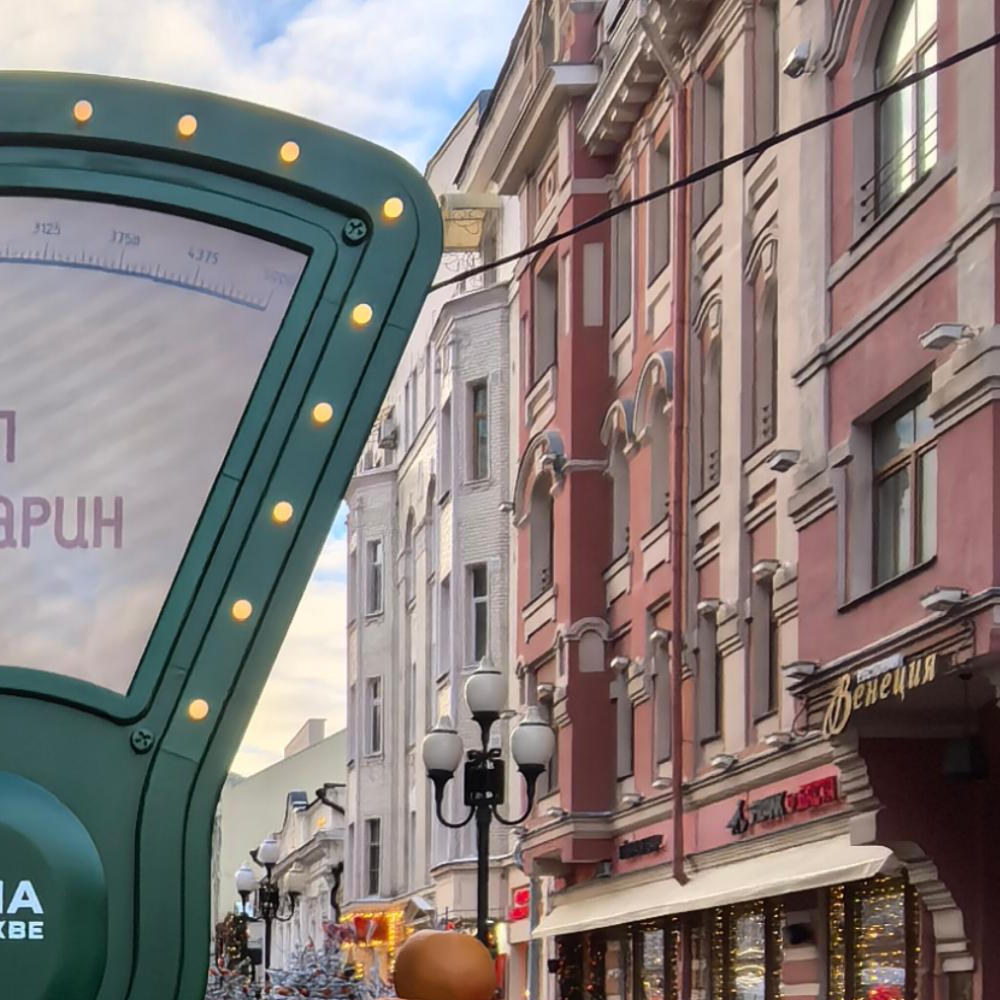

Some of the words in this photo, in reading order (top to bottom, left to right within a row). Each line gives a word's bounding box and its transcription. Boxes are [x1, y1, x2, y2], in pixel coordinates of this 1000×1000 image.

[32, 221, 61, 236] 3125
[111, 229, 140, 246] 3750
[187, 247, 220, 265] 4375
[822, 652, 937, 740] Венеция
